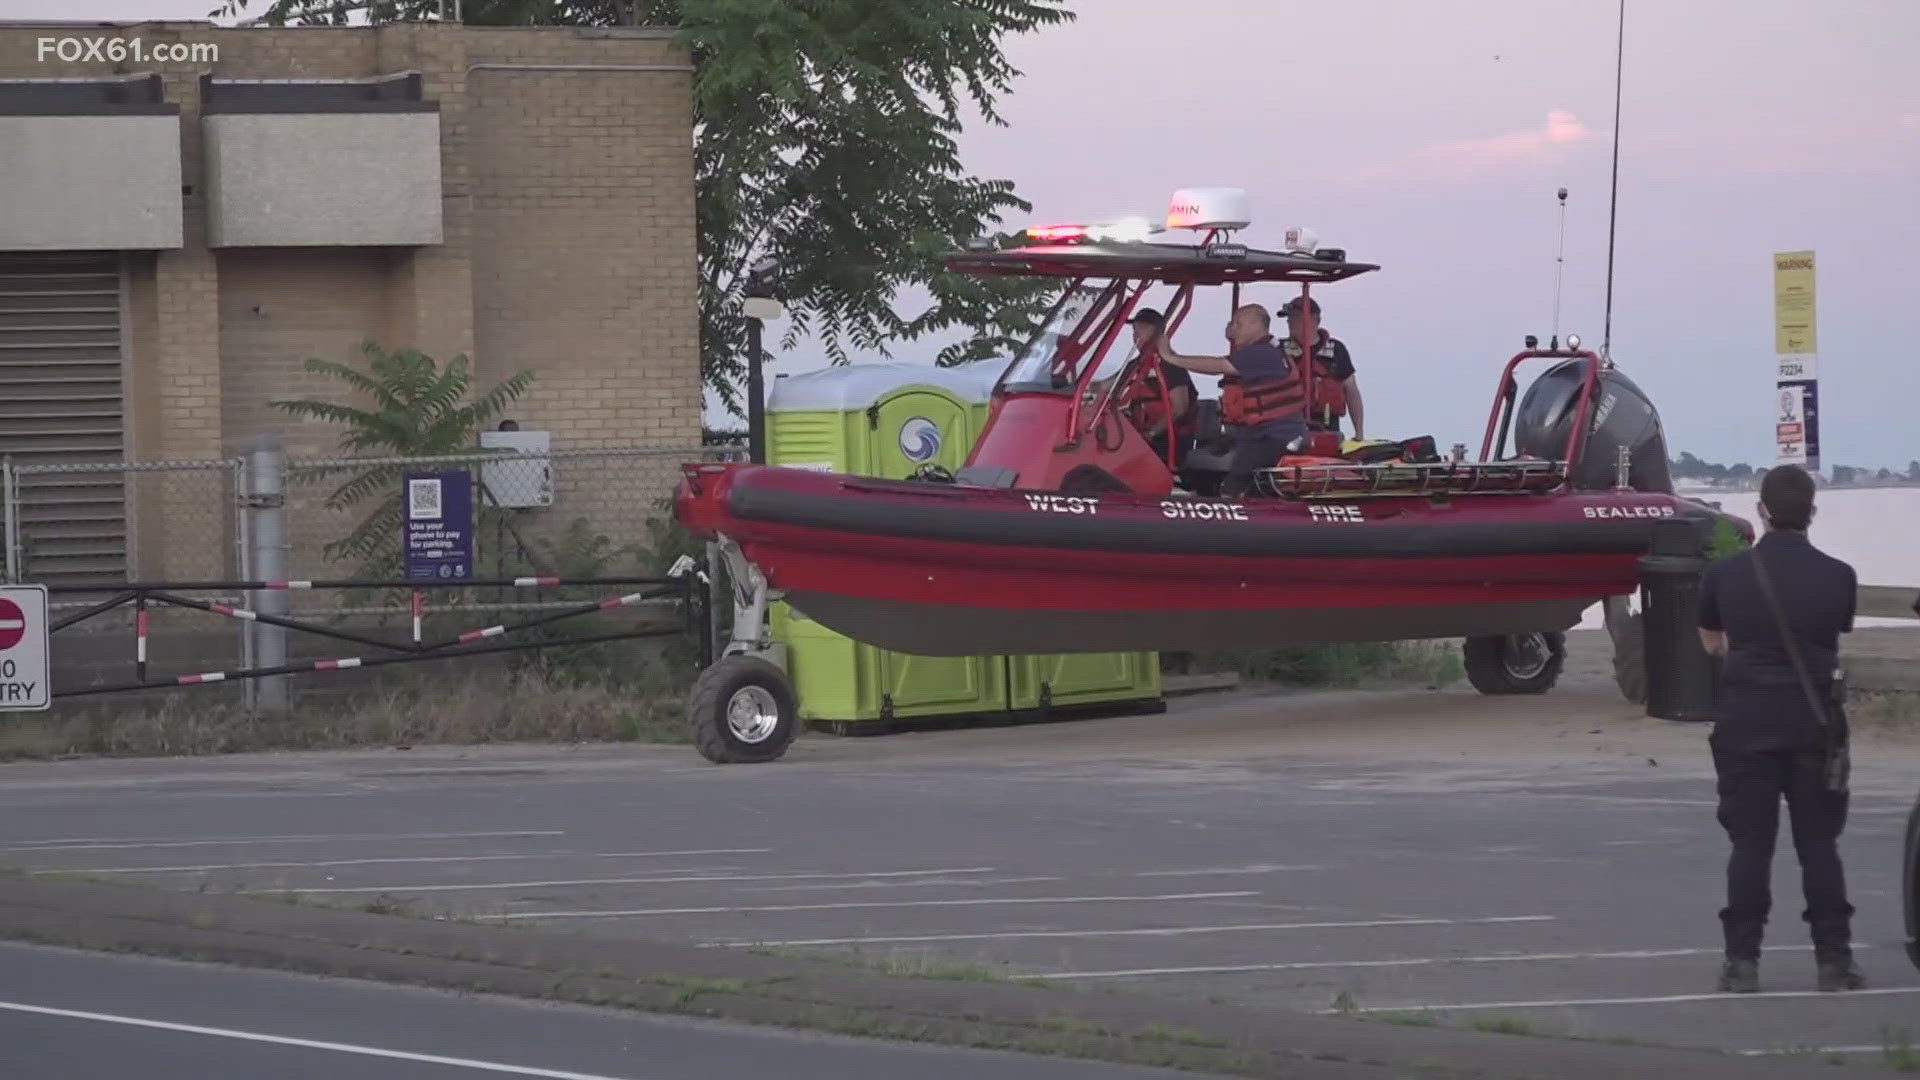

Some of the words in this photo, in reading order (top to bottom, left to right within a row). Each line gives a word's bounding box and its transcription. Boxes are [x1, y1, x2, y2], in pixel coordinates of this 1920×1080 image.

[1025, 494, 1099, 515] WEST
[1160, 501, 1249, 521] SHORE
[1308, 504, 1365, 523] FIRE
[1583, 505, 1675, 519] SEALEGS
[409, 523, 425, 531] Use
[426, 523, 445, 533] your
[410, 531, 435, 541] phone
[436, 531, 445, 539] to
[445, 531, 460, 541] pay
